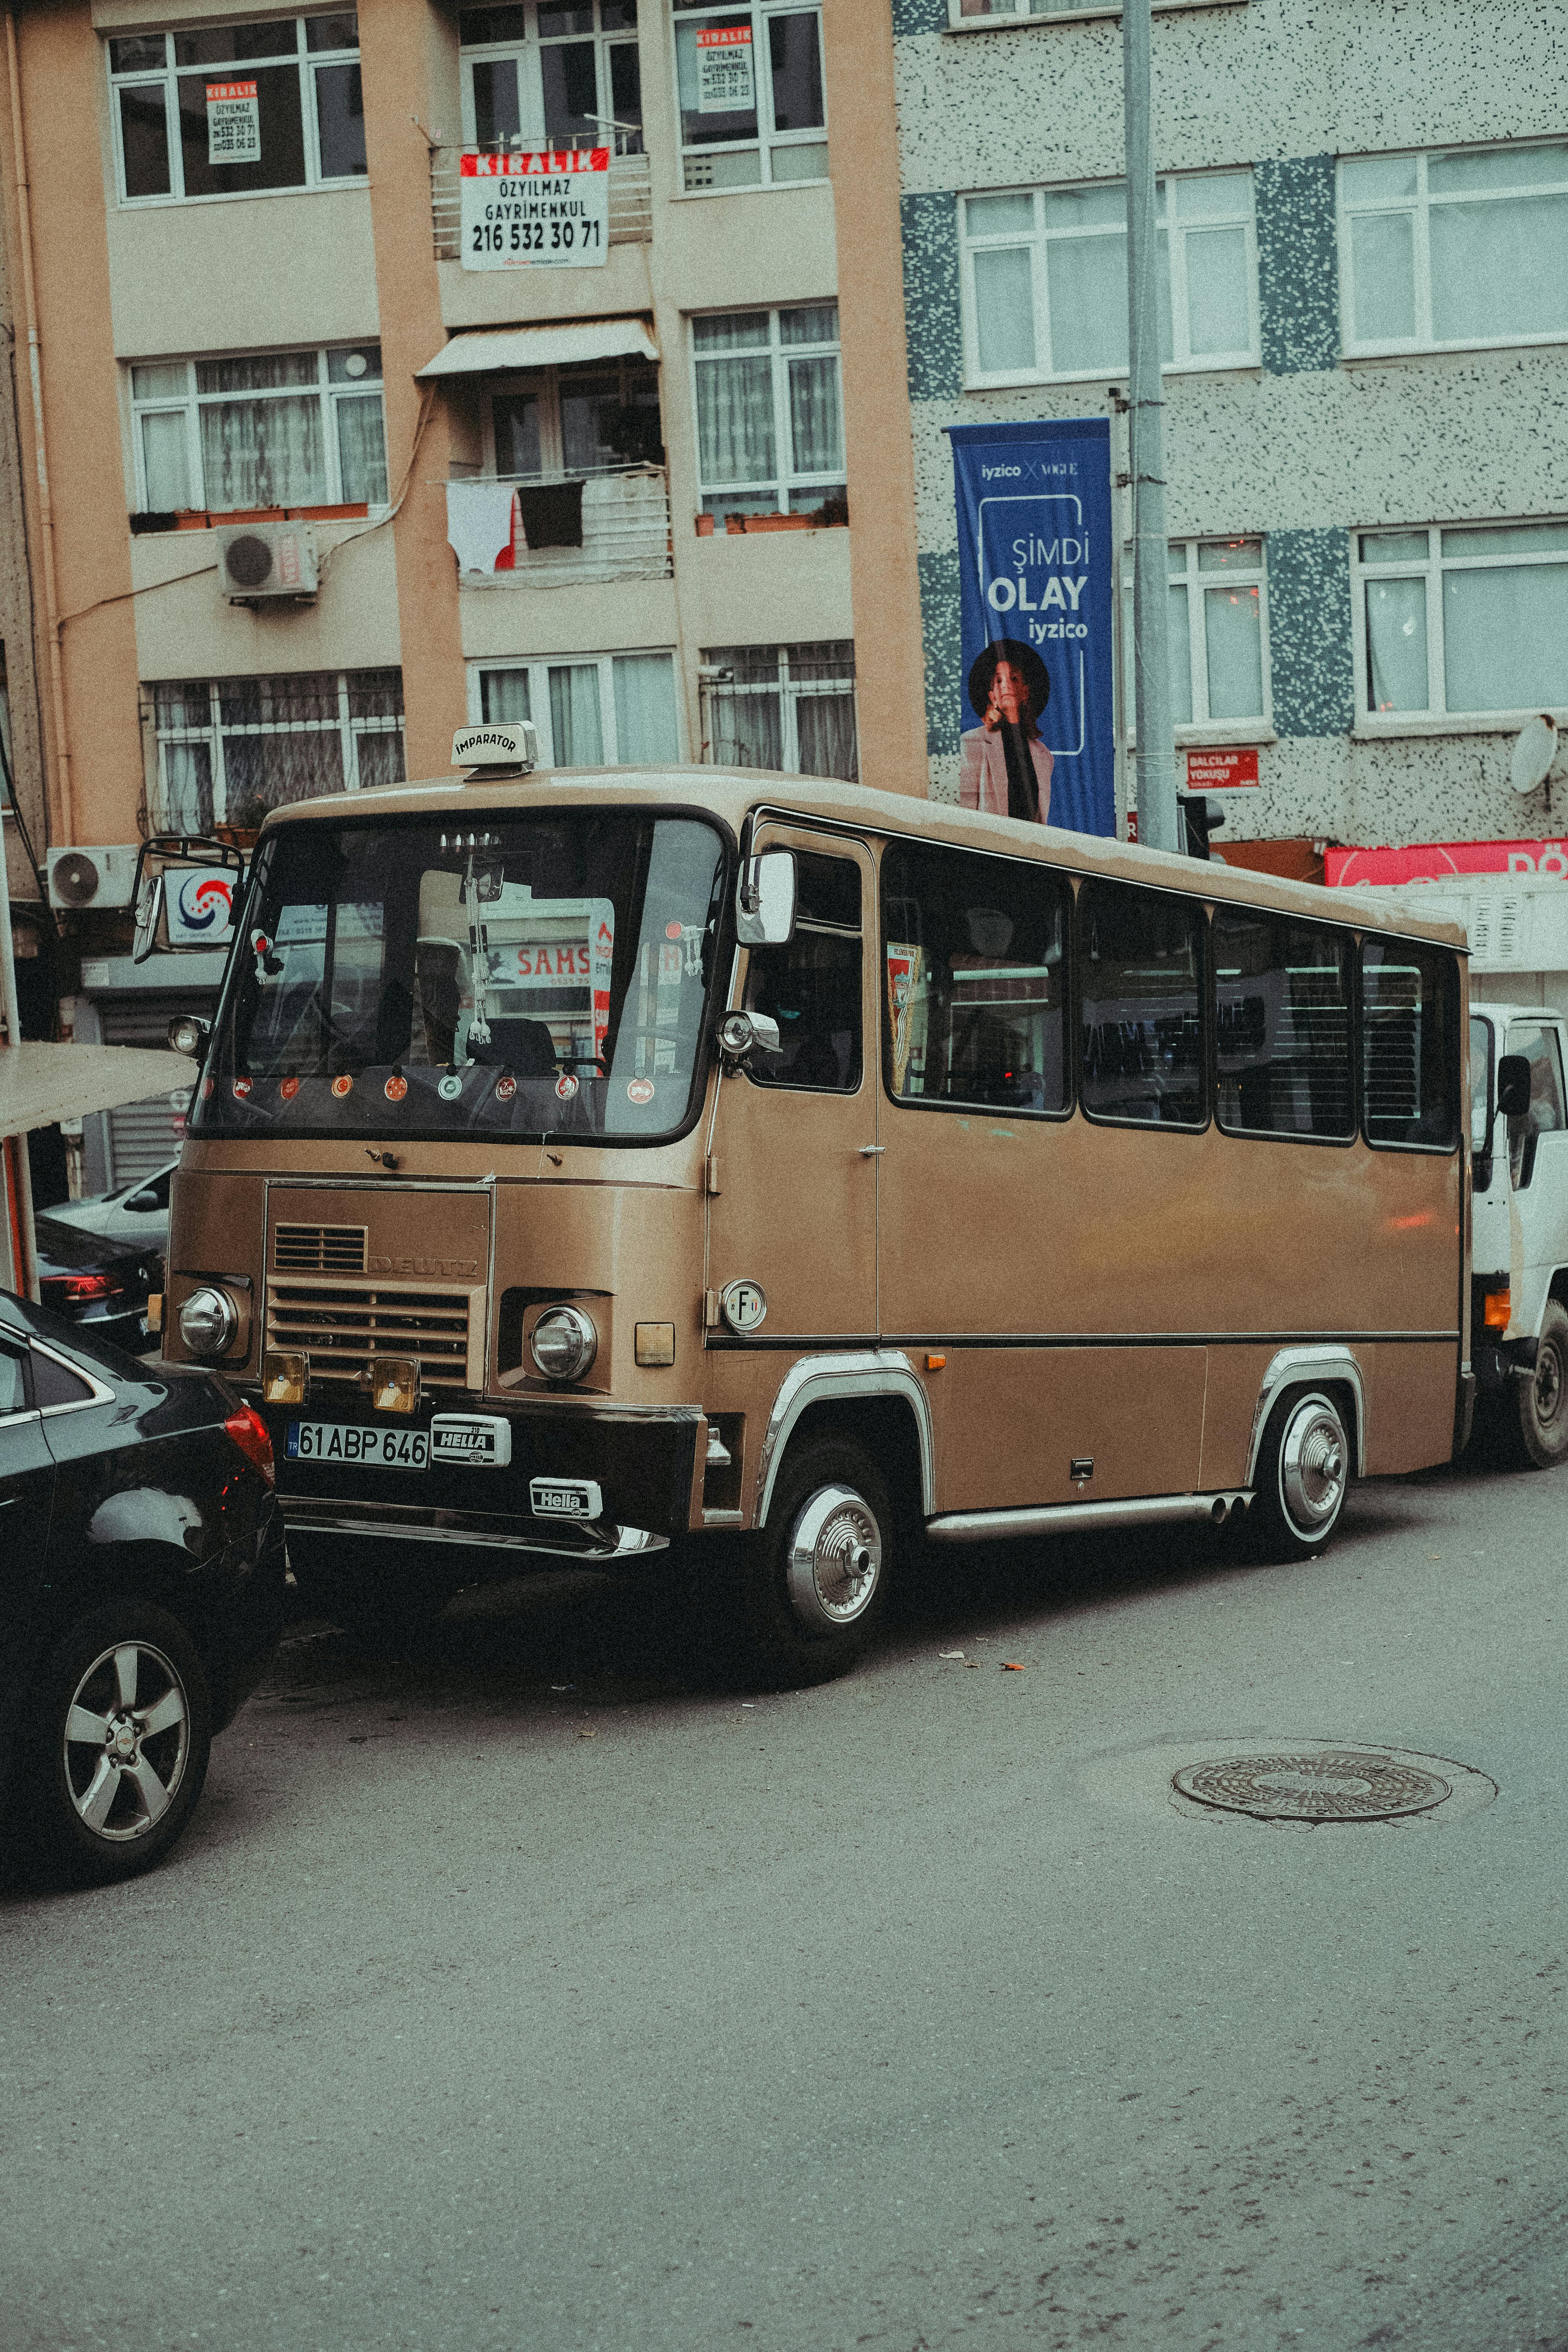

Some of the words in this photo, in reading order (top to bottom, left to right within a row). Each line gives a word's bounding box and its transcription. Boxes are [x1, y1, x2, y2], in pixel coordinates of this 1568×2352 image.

[477, 150, 594, 175] KİRALIK
[500, 179, 571, 198] ÖZYILMAZ
[485, 200, 586, 220] GAYRİMENKUL
[473, 224, 503, 252] 216
[510, 222, 544, 250] 532
[551, 221, 574, 248] 30
[582, 220, 600, 248] 71
[982, 464, 1021, 481] iyzico
[1012, 531, 1089, 574] ŞİMDİ
[987, 576, 1088, 612] OLAY
[1029, 618, 1088, 645] iyzico
[455, 733, 516, 756] İMPARATOR
[368, 1256, 477, 1277] DEUTZ
[738, 1291, 749, 1320] F
[289, 1442, 298, 1450] TR
[299, 1426, 323, 1456] 61
[327, 1428, 378, 1460] ABP
[383, 1432, 426, 1465] 646
[440, 1433, 486, 1449] HELLA
[541, 1493, 580, 1508] Hella
